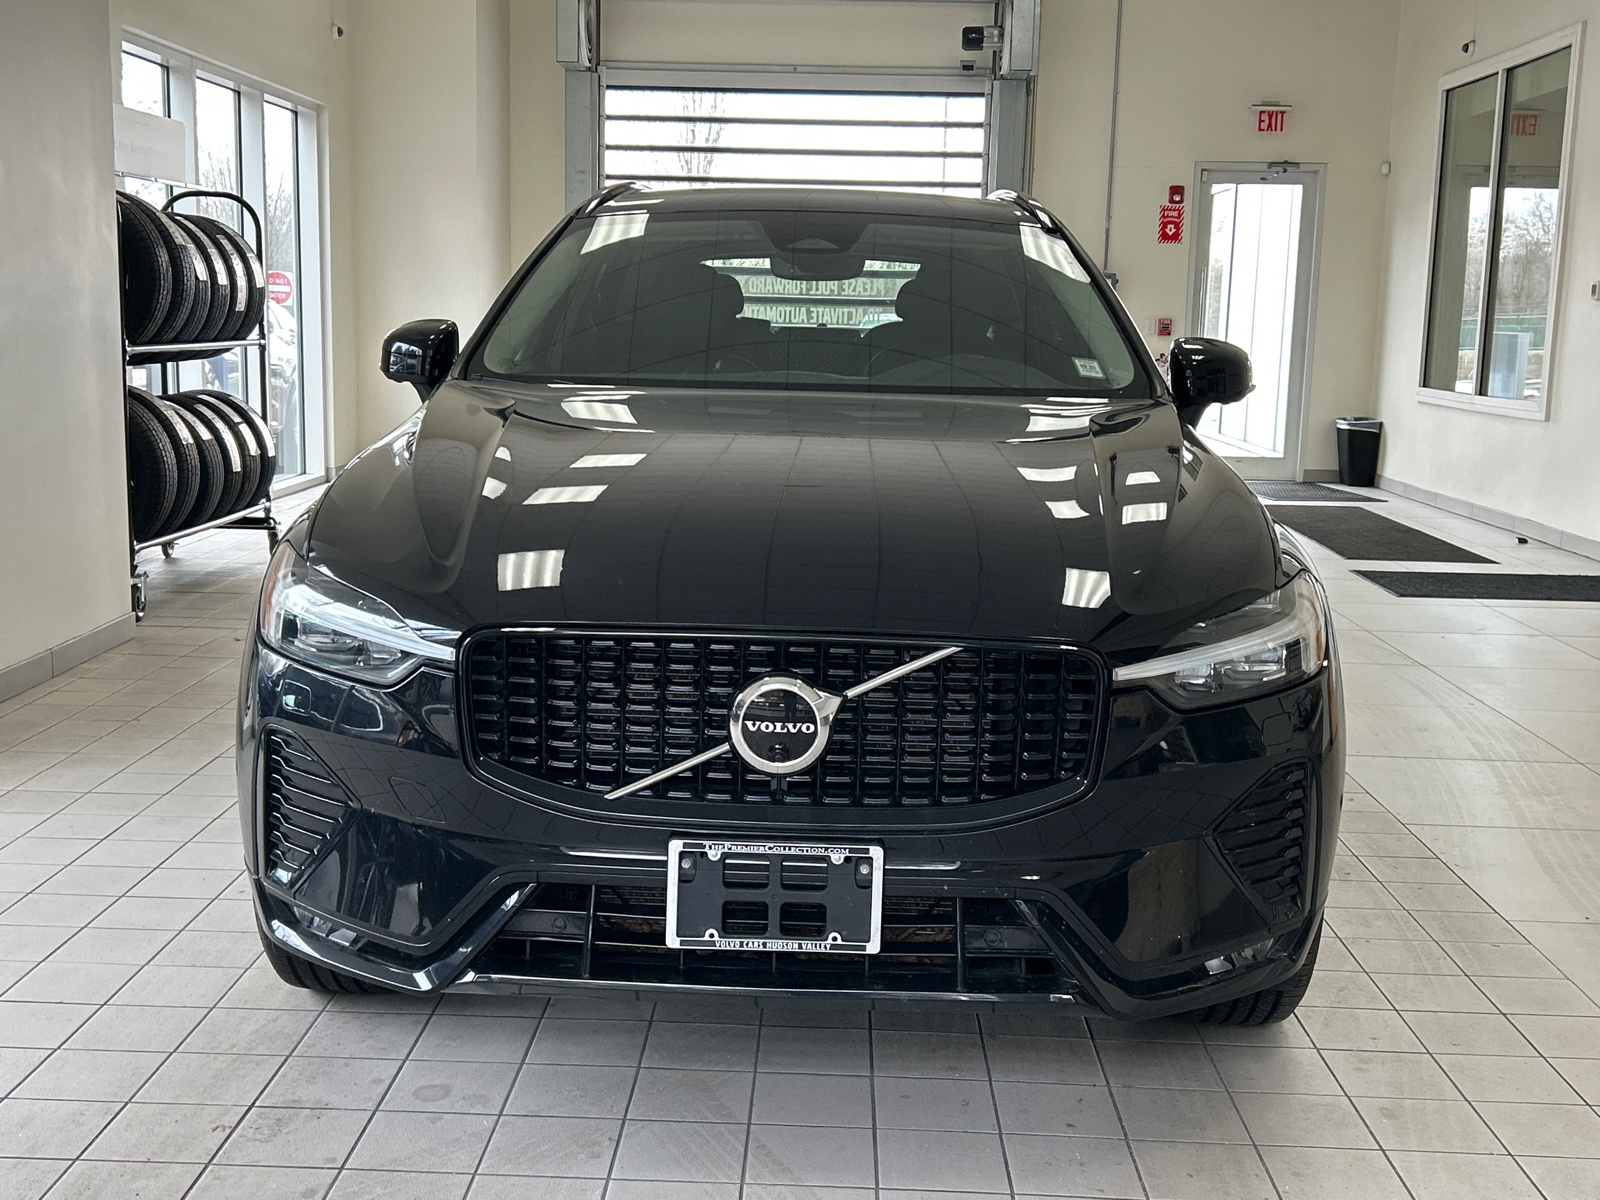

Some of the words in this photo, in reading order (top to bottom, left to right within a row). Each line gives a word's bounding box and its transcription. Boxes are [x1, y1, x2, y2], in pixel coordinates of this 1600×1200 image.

[1258, 110, 1286, 132] EXIT
[744, 721, 815, 734] VOLVO
[715, 940, 740, 948] VOLVO
[743, 941, 763, 949] CARS
[766, 941, 799, 950] HUDSON
[802, 942, 831, 951] VALLEY
